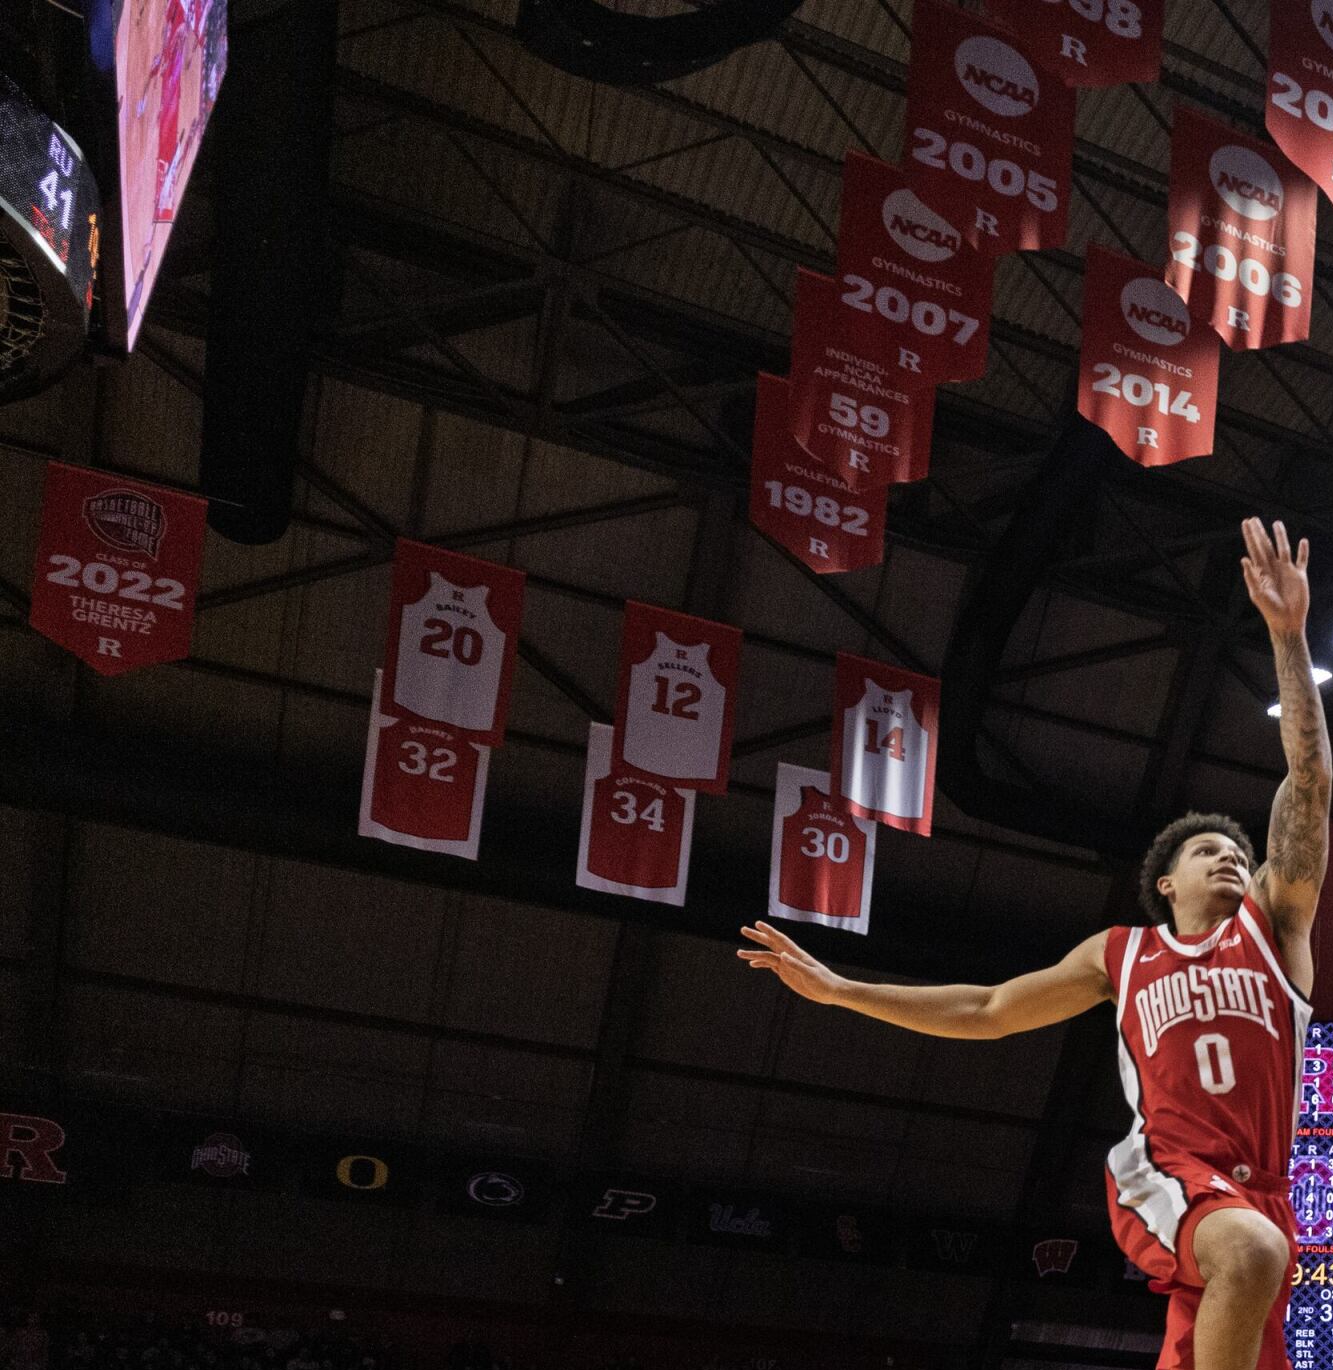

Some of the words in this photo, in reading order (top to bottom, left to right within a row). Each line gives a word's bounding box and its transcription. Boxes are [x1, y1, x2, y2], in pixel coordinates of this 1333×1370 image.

[1060, 34, 1088, 67] R
[963, 64, 1036, 109] NCAA
[944, 109, 1041, 157] GYMNASTICS
[912, 127, 1058, 213] 2005
[1217, 172, 1282, 212] NCAA
[890, 215, 958, 250] NCAA
[975, 207, 999, 237] R
[1201, 215, 1287, 257] GYMNASTICS
[872, 257, 963, 296] GYMNASTICS
[1173, 231, 1302, 309] 2006
[841, 274, 980, 346] 2007
[1128, 303, 1188, 338] NCAA
[1227, 305, 1250, 331] R
[898, 347, 921, 373] R
[1113, 343, 1193, 378] GYMNASTICS
[813, 366, 910, 405] APPEARANCES
[1092, 362, 1200, 424] 2014
[829, 392, 890, 439] 59
[817, 423, 900, 457] GYMNASTICS
[1136, 426, 1159, 449] R
[849, 448, 870, 474] R
[764, 479, 870, 537] 1982
[809, 537, 829, 559] R
[46, 553, 186, 611] 2022
[69, 595, 157, 624] THERESA
[72, 608, 151, 635] GRENTZ
[97, 635, 122, 658] R
[420, 618, 483, 666] 20
[652, 675, 702, 721] 12
[865, 719, 906, 762] 14
[398, 740, 458, 783] 32
[610, 790, 666, 833] 34
[800, 827, 850, 864] 30
[1136, 971, 1192, 1057] OHIO
[1188, 964, 1279, 1040] STATE
[1312, 1028, 1322, 1038] R
[1193, 1033, 1236, 1094] 0
[1312, 1062, 1321, 1072] 3
[1308, 1145, 1318, 1154] R
[336, 1154, 390, 1192] O
[592, 1188, 657, 1220] P
[1305, 1210, 1313, 1220] 2
[1326, 1210, 1333, 1220] 0
[1306, 1193, 1314, 1202] 4
[1326, 1193, 1333, 1202] 0
[1326, 1227, 1332, 1237] 3
[1298, 1306, 1314, 1314] 2ND
[1296, 1329, 1315, 1338] REB
[1296, 1340, 1314, 1348] BLK
[1296, 1350, 1314, 1358] STL
